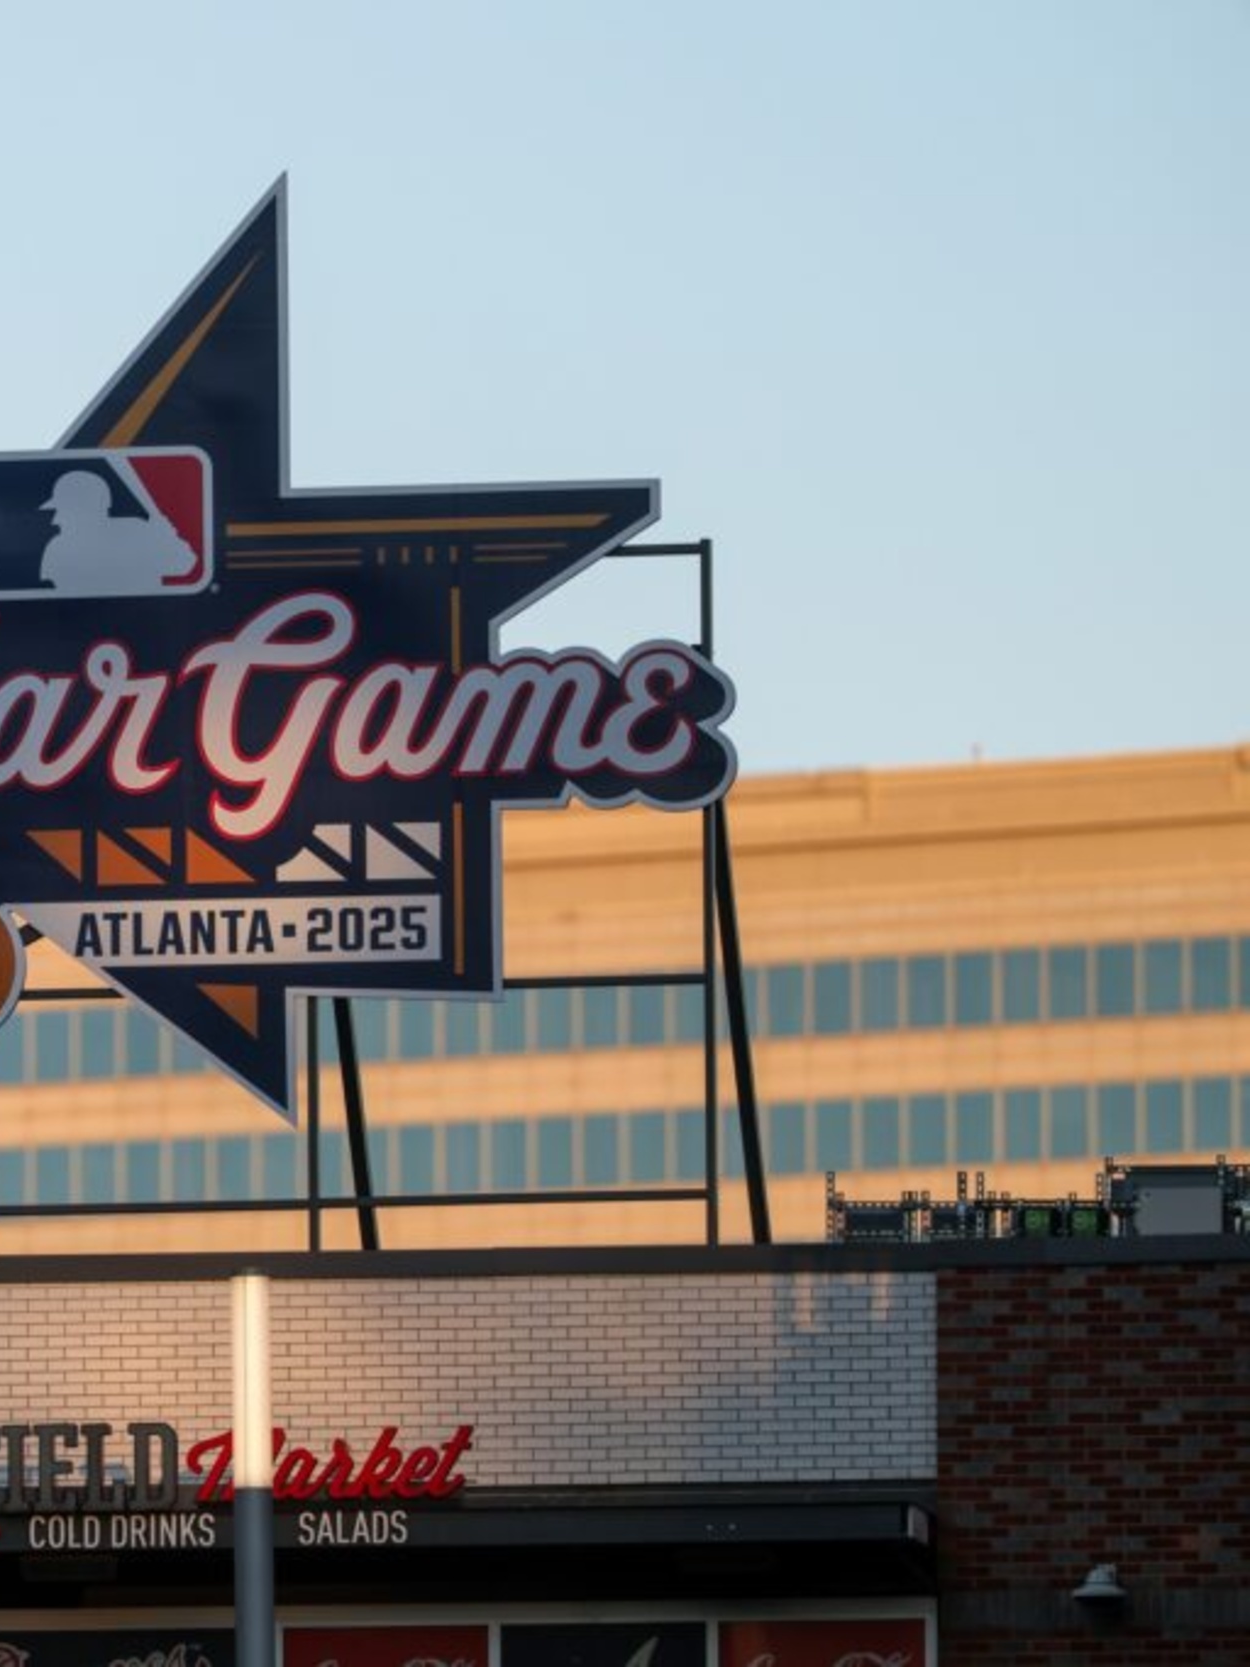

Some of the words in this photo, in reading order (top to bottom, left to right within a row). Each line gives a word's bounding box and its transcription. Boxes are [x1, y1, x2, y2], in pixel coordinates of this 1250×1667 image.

[178, 590, 694, 841] Game
[74, 909, 275, 957] ATLANTA
[306, 905, 427, 953] 2025
[27, 1513, 101, 1549] COLD
[110, 1512, 216, 1549] DRINKS
[297, 1509, 409, 1546] SALADS
